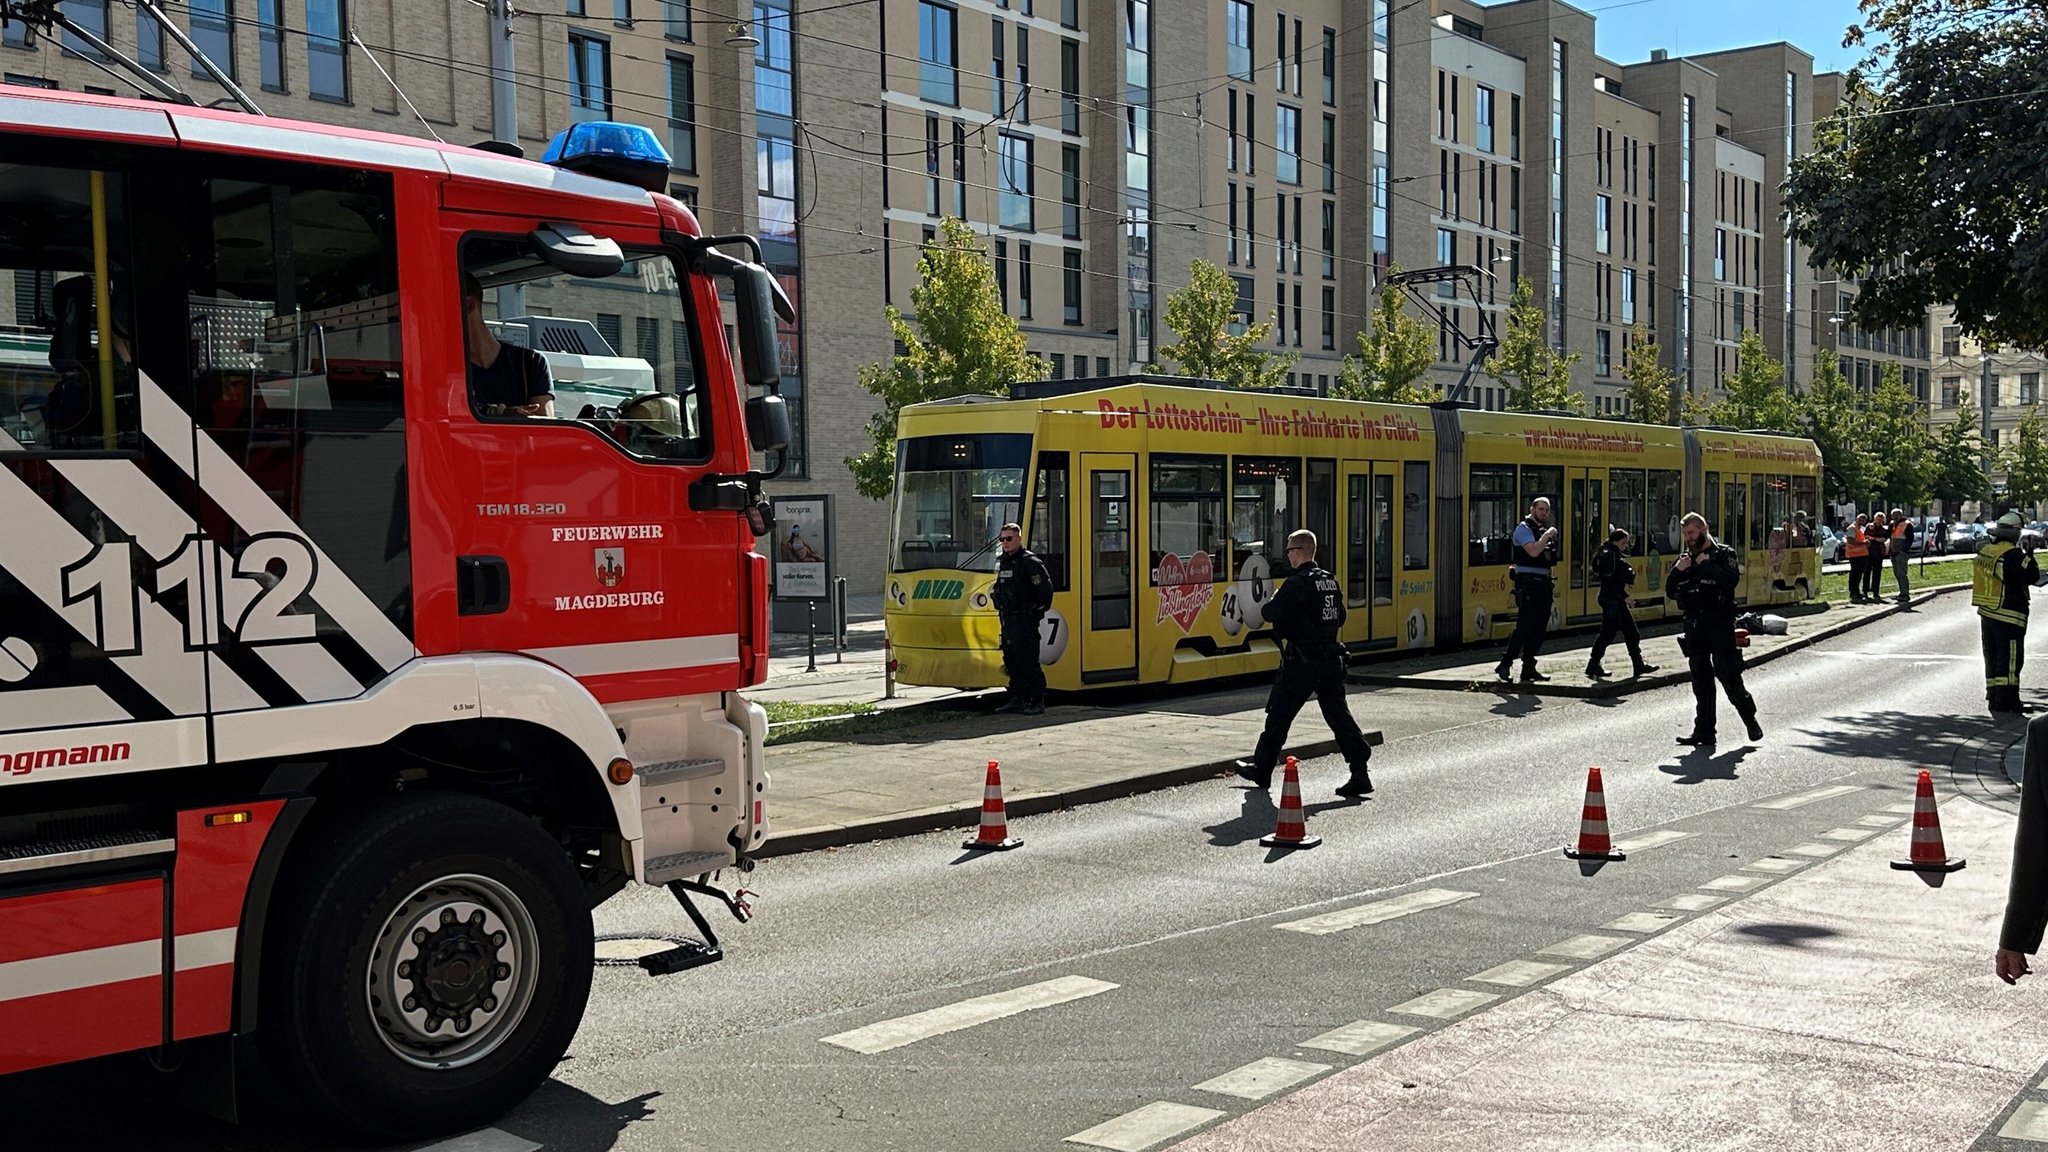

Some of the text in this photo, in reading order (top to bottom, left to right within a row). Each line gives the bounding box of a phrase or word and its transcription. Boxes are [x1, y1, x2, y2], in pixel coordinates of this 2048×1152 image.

[1098, 399, 1139, 428] Der
[1144, 399, 1243, 433] Lottoschein
[1258, 407, 1290, 436] Ihre
[1291, 409, 1360, 439] Fahrkarte
[1360, 411, 1381, 440] ins
[1383, 413, 1420, 441] Glück
[476, 503, 567, 516] TGM 18.320
[552, 524, 664, 542] FEUERWEHR
[60, 531, 318, 658] 112
[1500, 575, 1506, 592] 6
[555, 591, 665, 611] MAGDEBURG
[1221, 592, 1237, 619] 24
[1325, 595, 1335, 608] ST
[1047, 618, 1060, 645] 7
[1407, 615, 1418, 643] 18
[0, 742, 130, 776] ngmann
